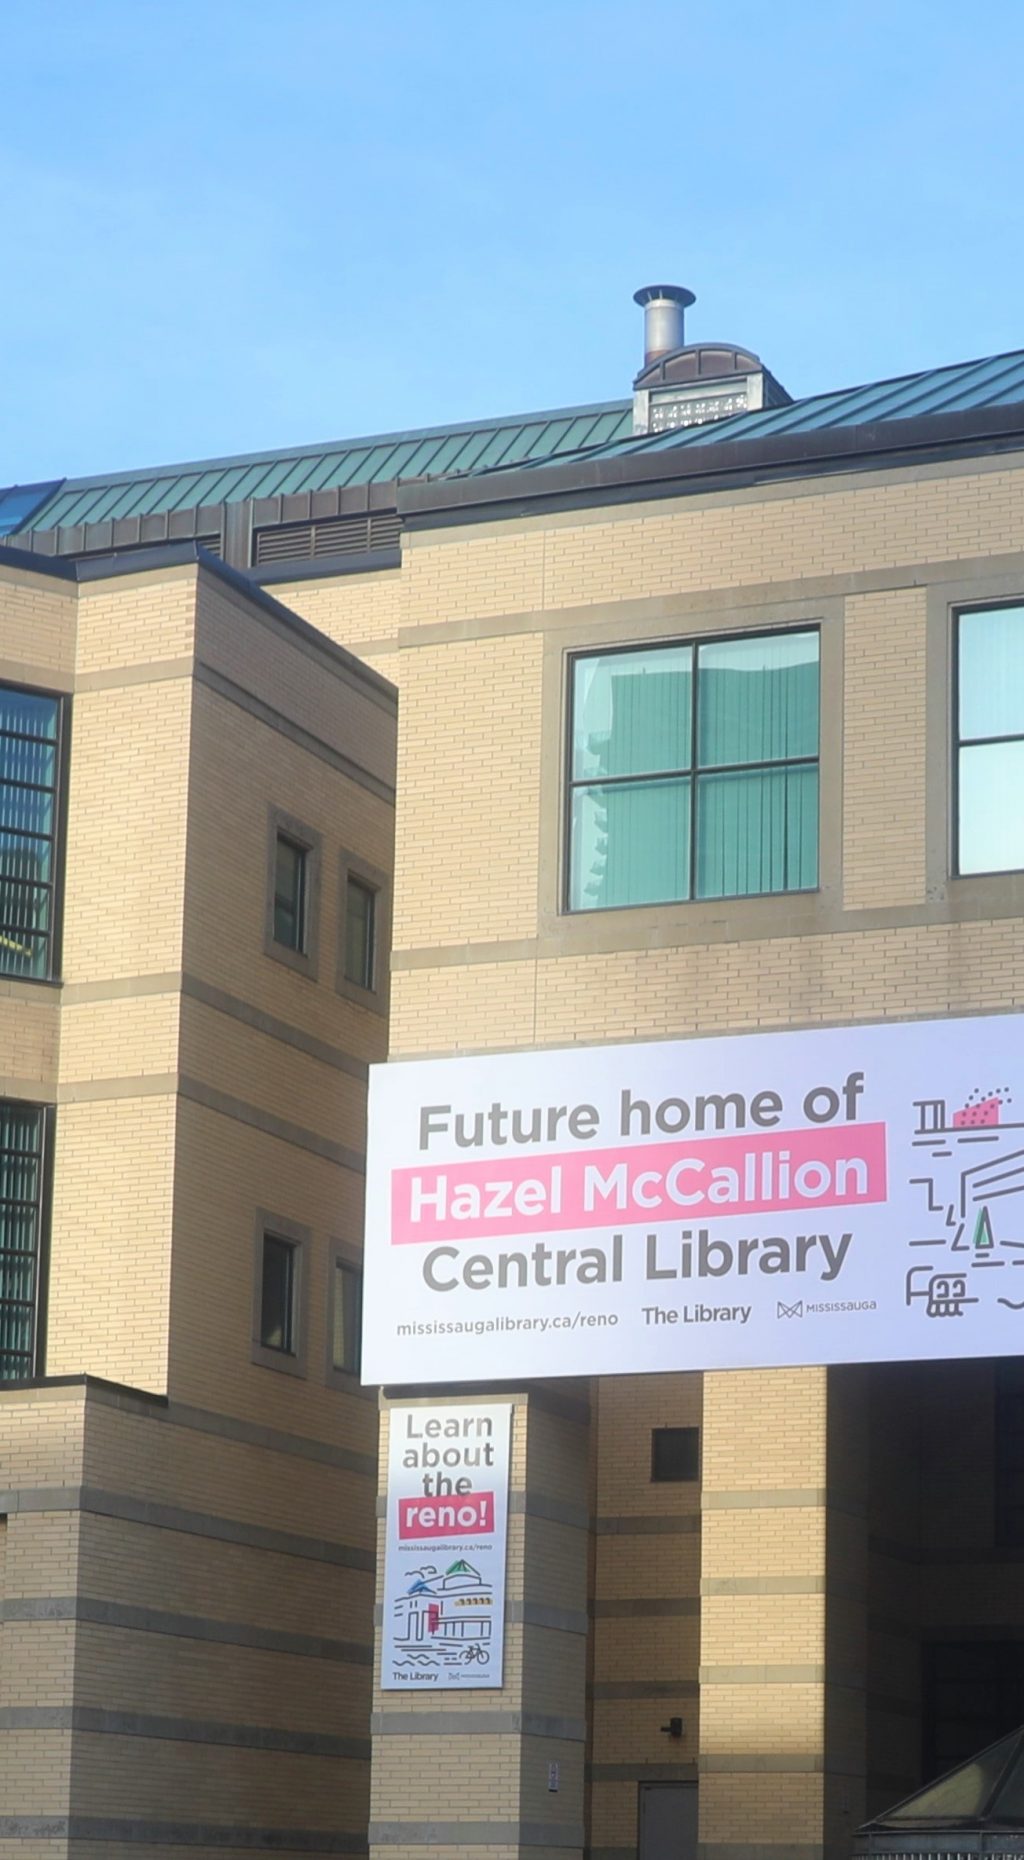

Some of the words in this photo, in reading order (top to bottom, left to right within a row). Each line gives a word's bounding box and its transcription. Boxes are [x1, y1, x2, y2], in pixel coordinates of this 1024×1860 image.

[419, 1102, 600, 1151] Future
[620, 1089, 783, 1137] home
[803, 1071, 865, 1122] of
[410, 1165, 562, 1223] Hazel
[583, 1150, 868, 1212] McCallion
[422, 1234, 623, 1292] Central
[646, 1229, 853, 1282] Library
[396, 1311, 619, 1336] mississaugalibrary.ca/reno
[641, 1306, 679, 1325] The
[683, 1303, 752, 1324] Library
[406, 1413, 493, 1439] Learn
[402, 1442, 495, 1469] about
[422, 1471, 473, 1498] the
[405, 1500, 487, 1527] reno!
[392, 1671, 409, 1681] The
[409, 1671, 440, 1682] Library
